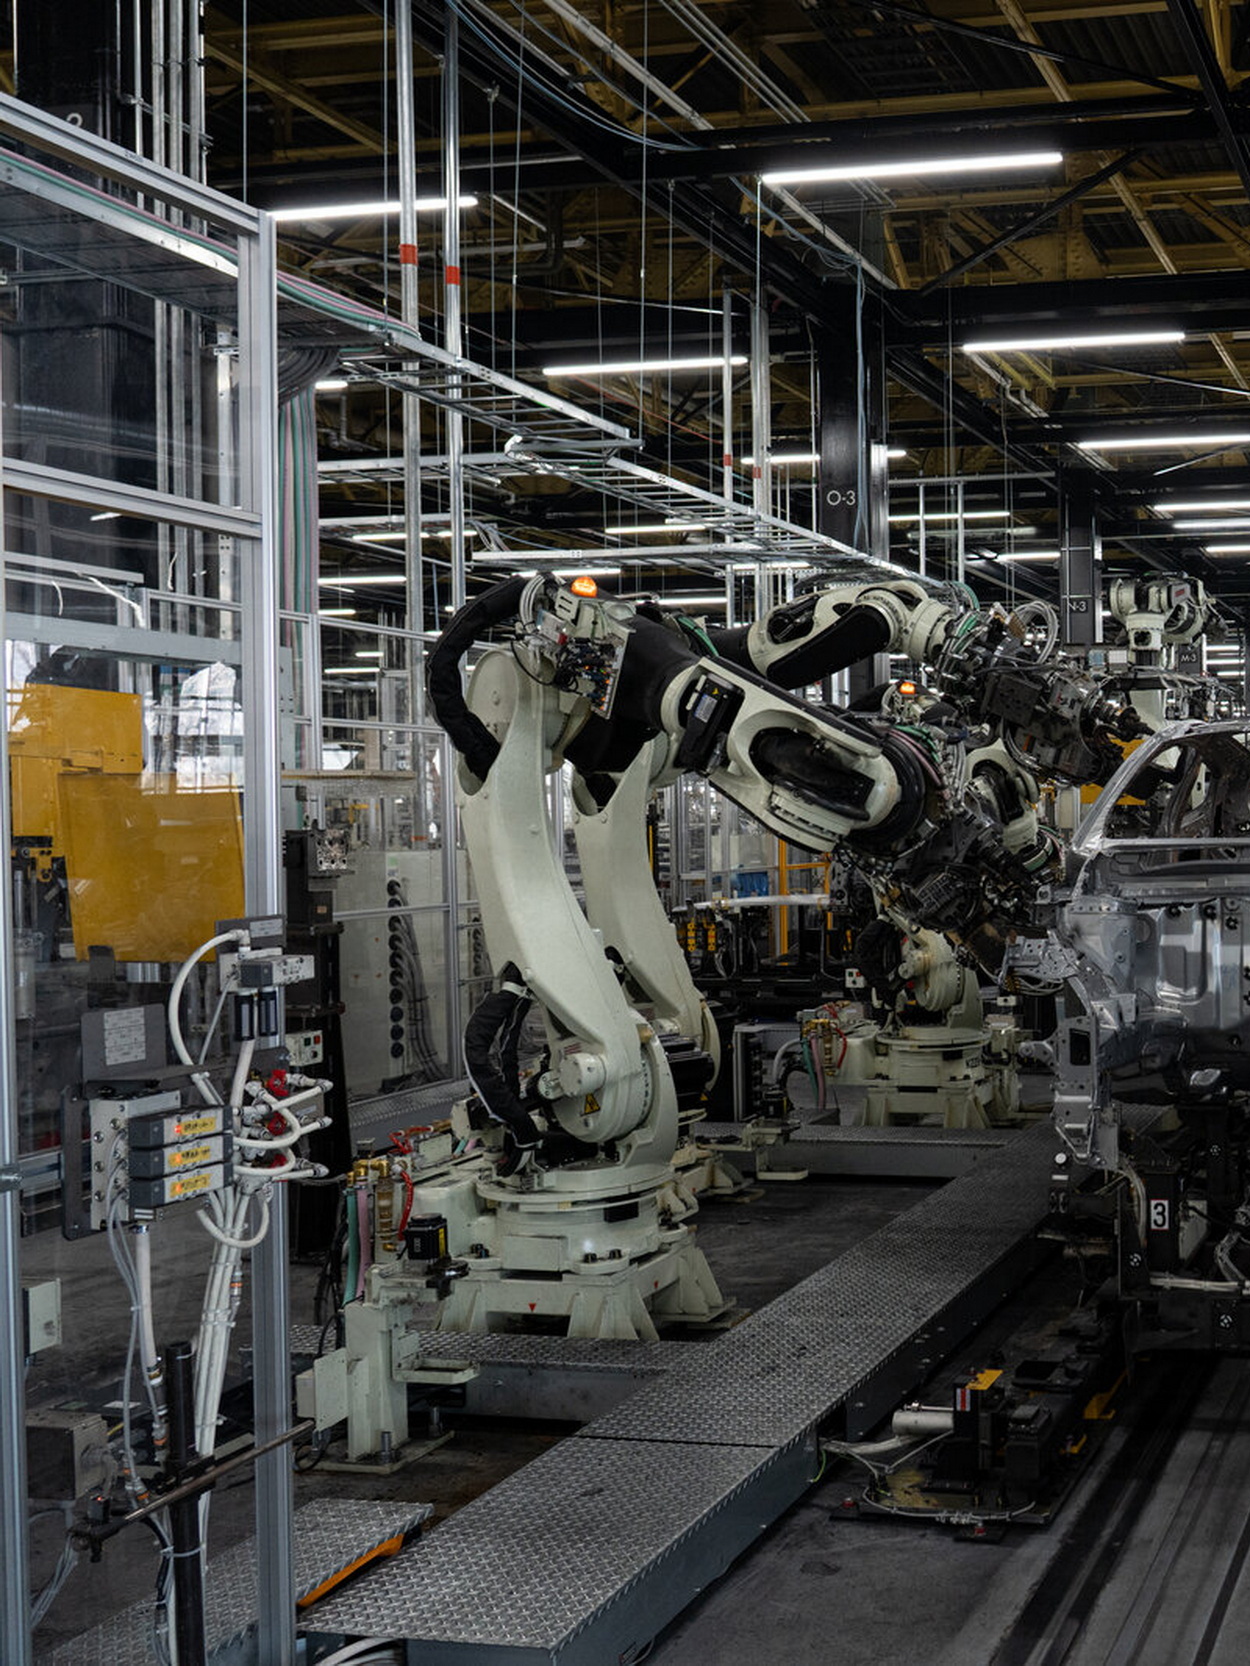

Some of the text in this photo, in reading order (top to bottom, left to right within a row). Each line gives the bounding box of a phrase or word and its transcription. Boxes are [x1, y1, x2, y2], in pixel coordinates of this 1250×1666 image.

[826, 489, 856, 506] O-3
[1068, 600, 1087, 613] N-3
[1153, 1202, 1166, 1227] 3
